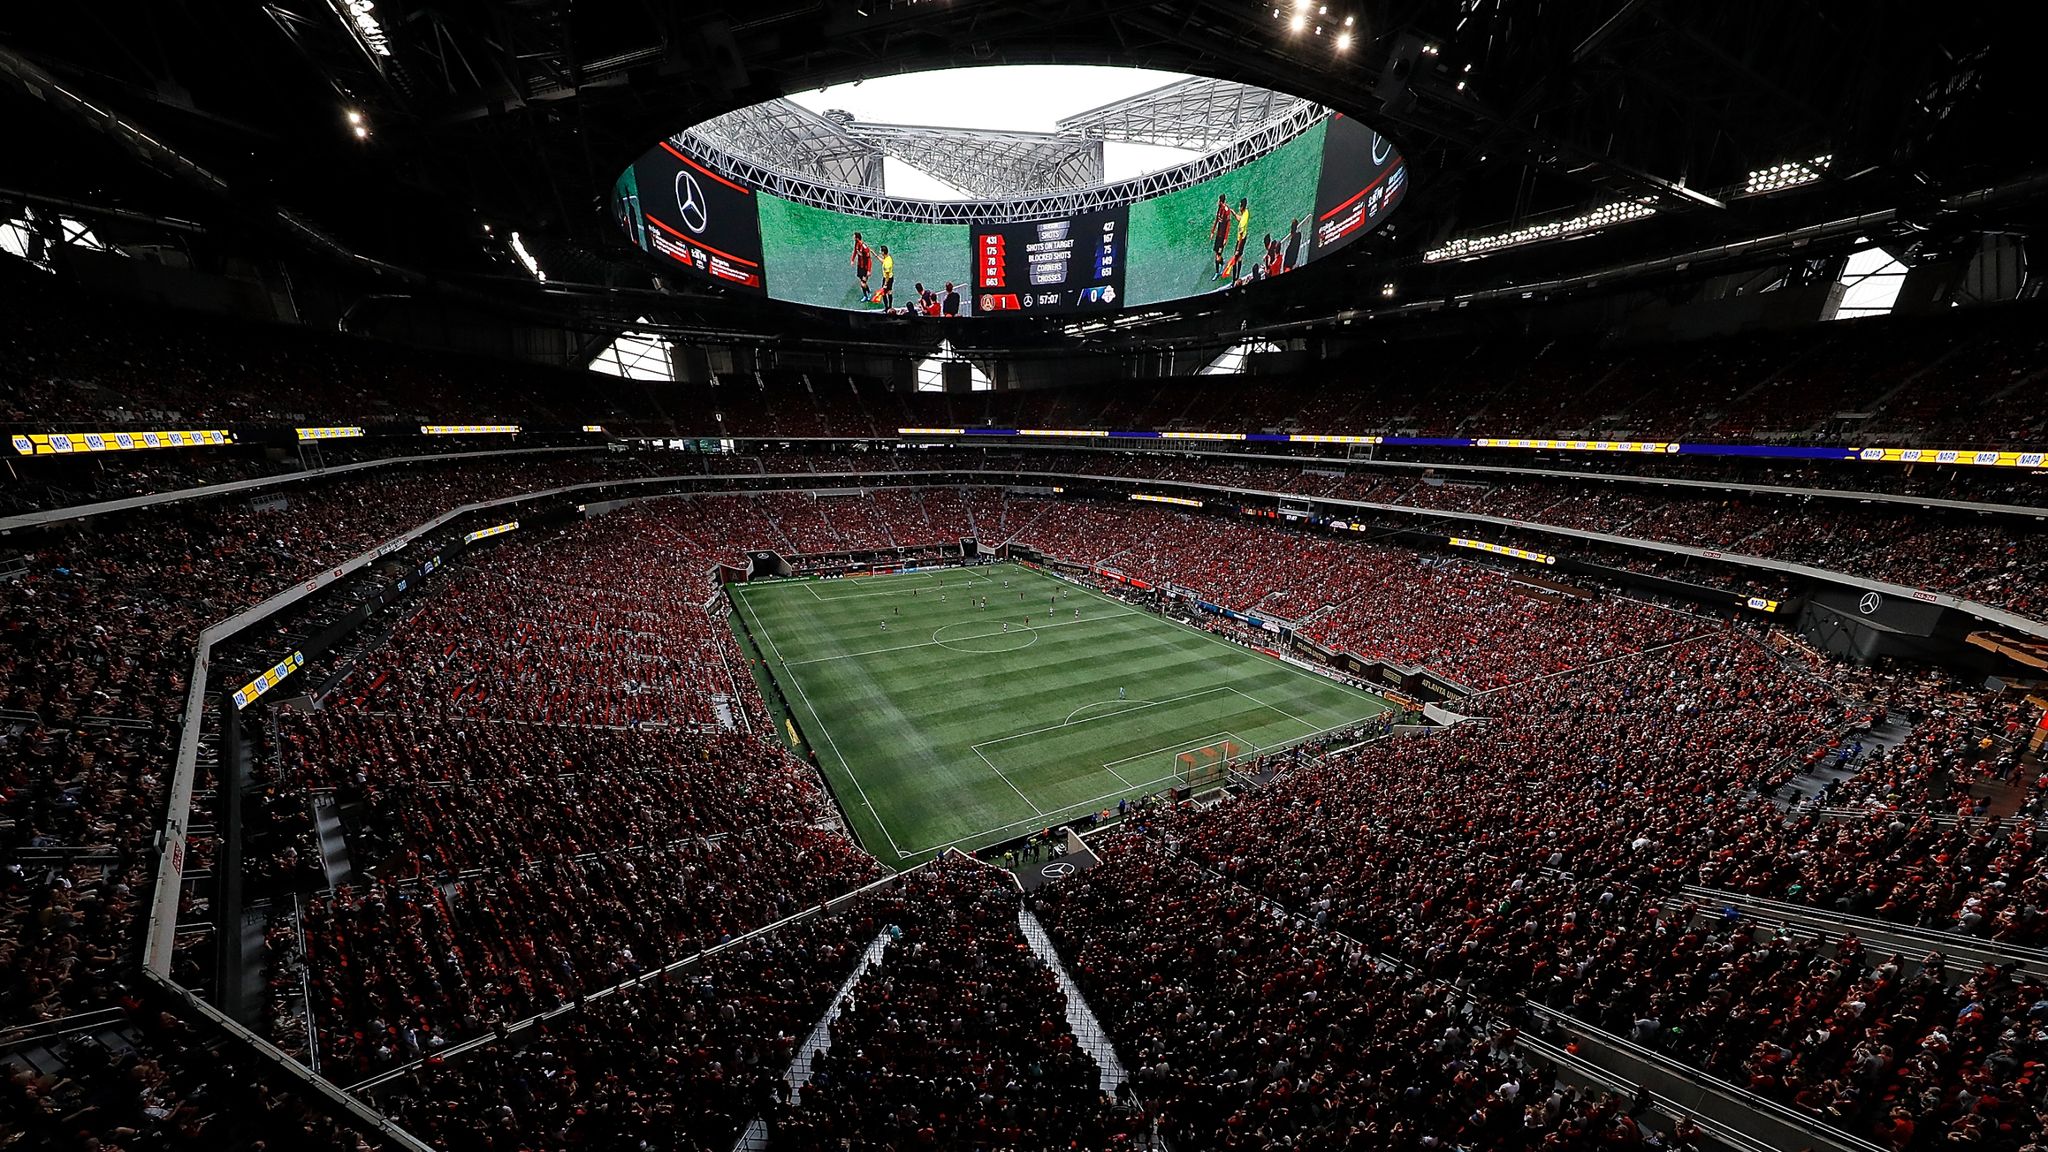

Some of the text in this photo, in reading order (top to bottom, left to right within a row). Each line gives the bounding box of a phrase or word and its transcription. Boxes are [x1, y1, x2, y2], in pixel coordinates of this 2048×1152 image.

[1041, 230, 1059, 239] SHOTS
[1026, 243, 1044, 251] SHOTS
[1053, 239, 1074, 249] TARGET
[1104, 245, 1112, 254] 75
[986, 247, 997, 255] 175
[1028, 251, 1071, 262] BLOCKED SHOTS
[988, 258, 996, 266] 78
[1037, 263, 1062, 271] CORNERS
[987, 268, 997, 276] 167
[1037, 274, 1061, 282] CROSSES
[1039, 295, 1058, 305] 57:07
[1091, 289, 1098, 302] 0
[1001, 296, 1006, 309] 1
[51, 436, 71, 449] NAPA
[86, 435, 104, 448] NAPA
[1864, 450, 2041, 464] NAPA NAPA NAPA NAPA NAPA
[1751, 599, 1764, 607] NAPA
[1421, 679, 1446, 696] ATLANTA
